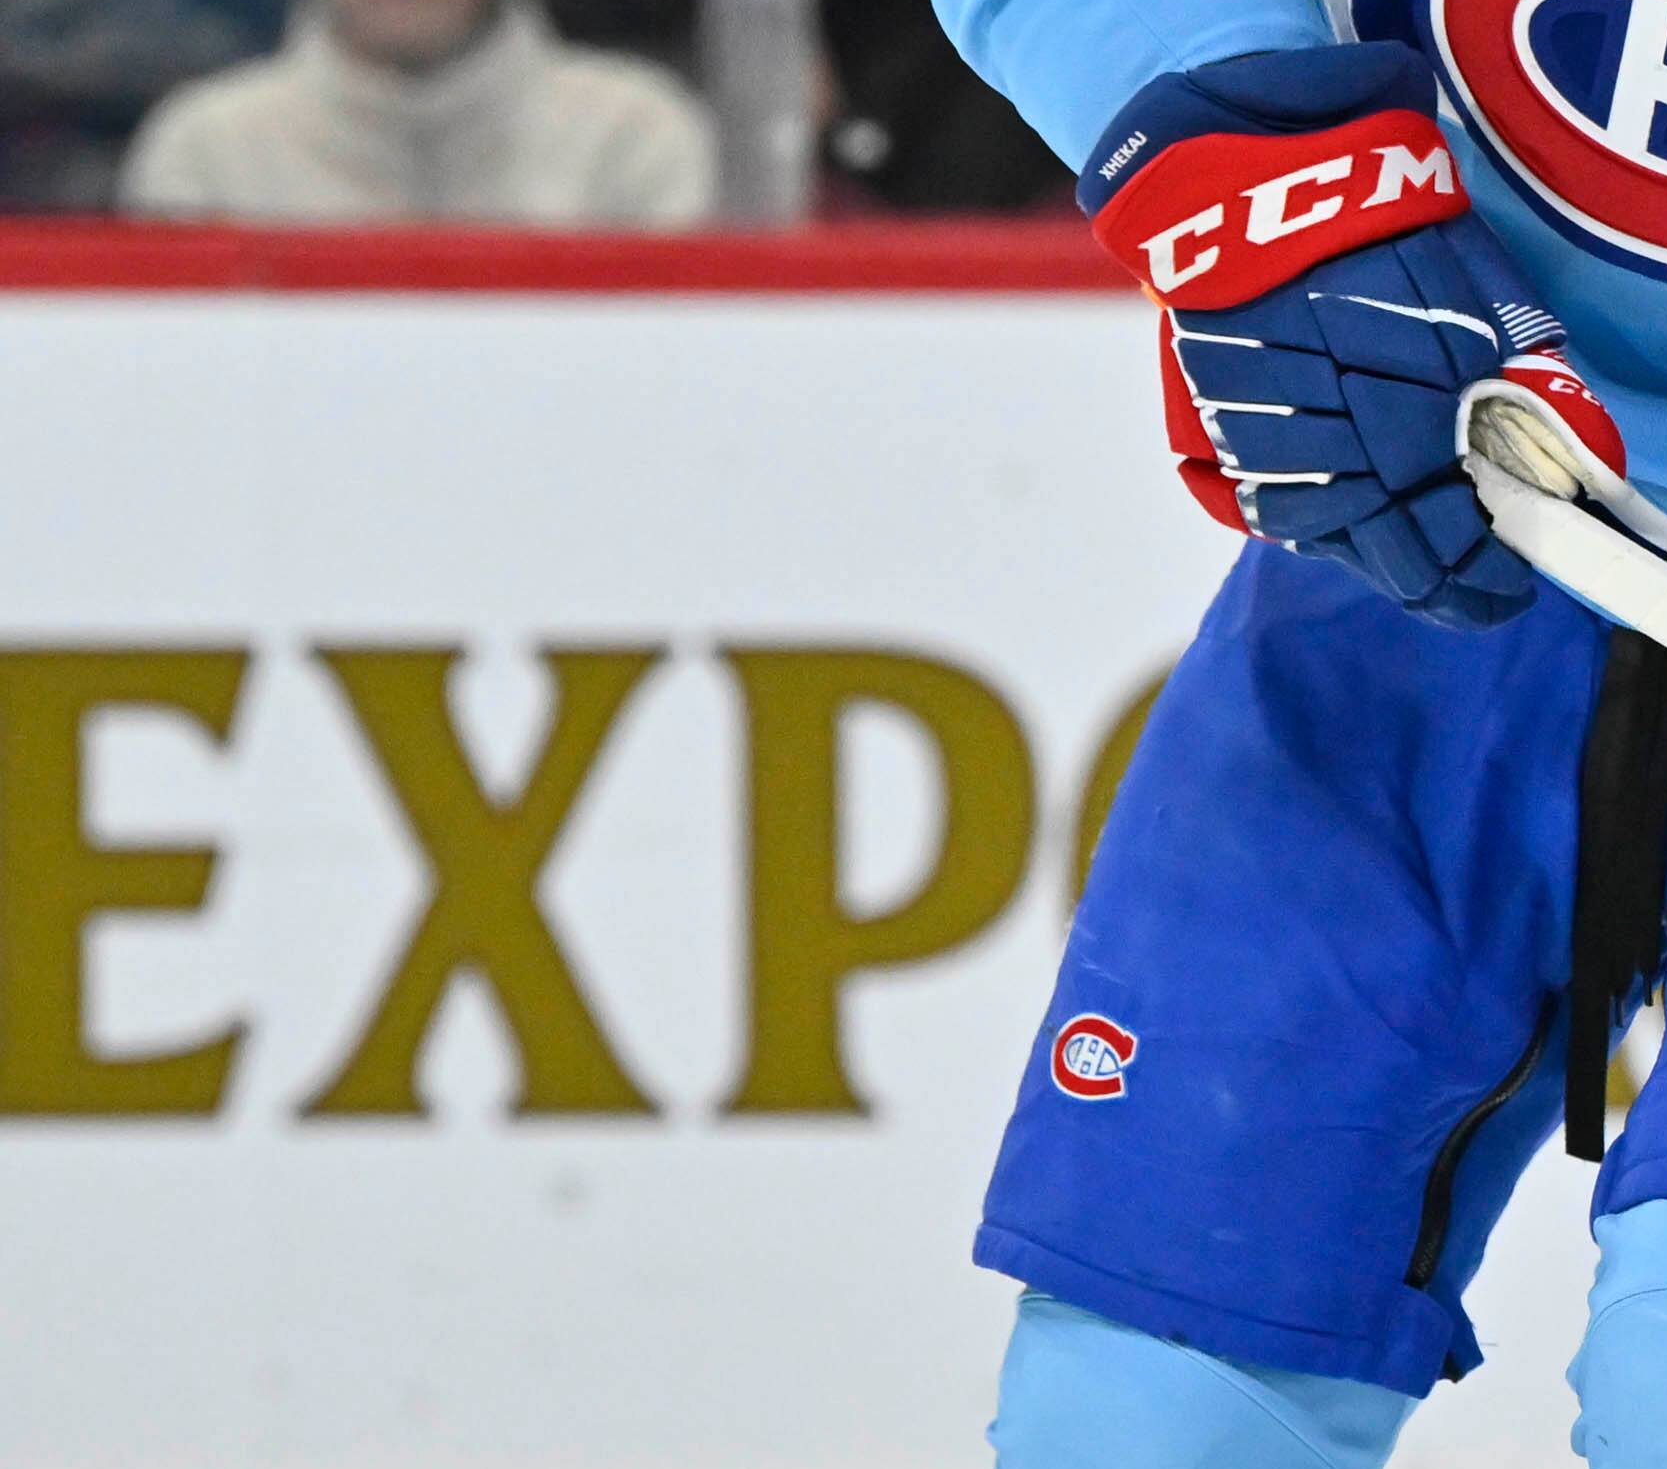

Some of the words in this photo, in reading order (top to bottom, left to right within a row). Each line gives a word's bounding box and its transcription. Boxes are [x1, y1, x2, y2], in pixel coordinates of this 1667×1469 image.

[1098, 130, 1148, 181] XHEKAJ
[1137, 145, 1458, 294] CCM
[0, 643, 1175, 1119] EXP
